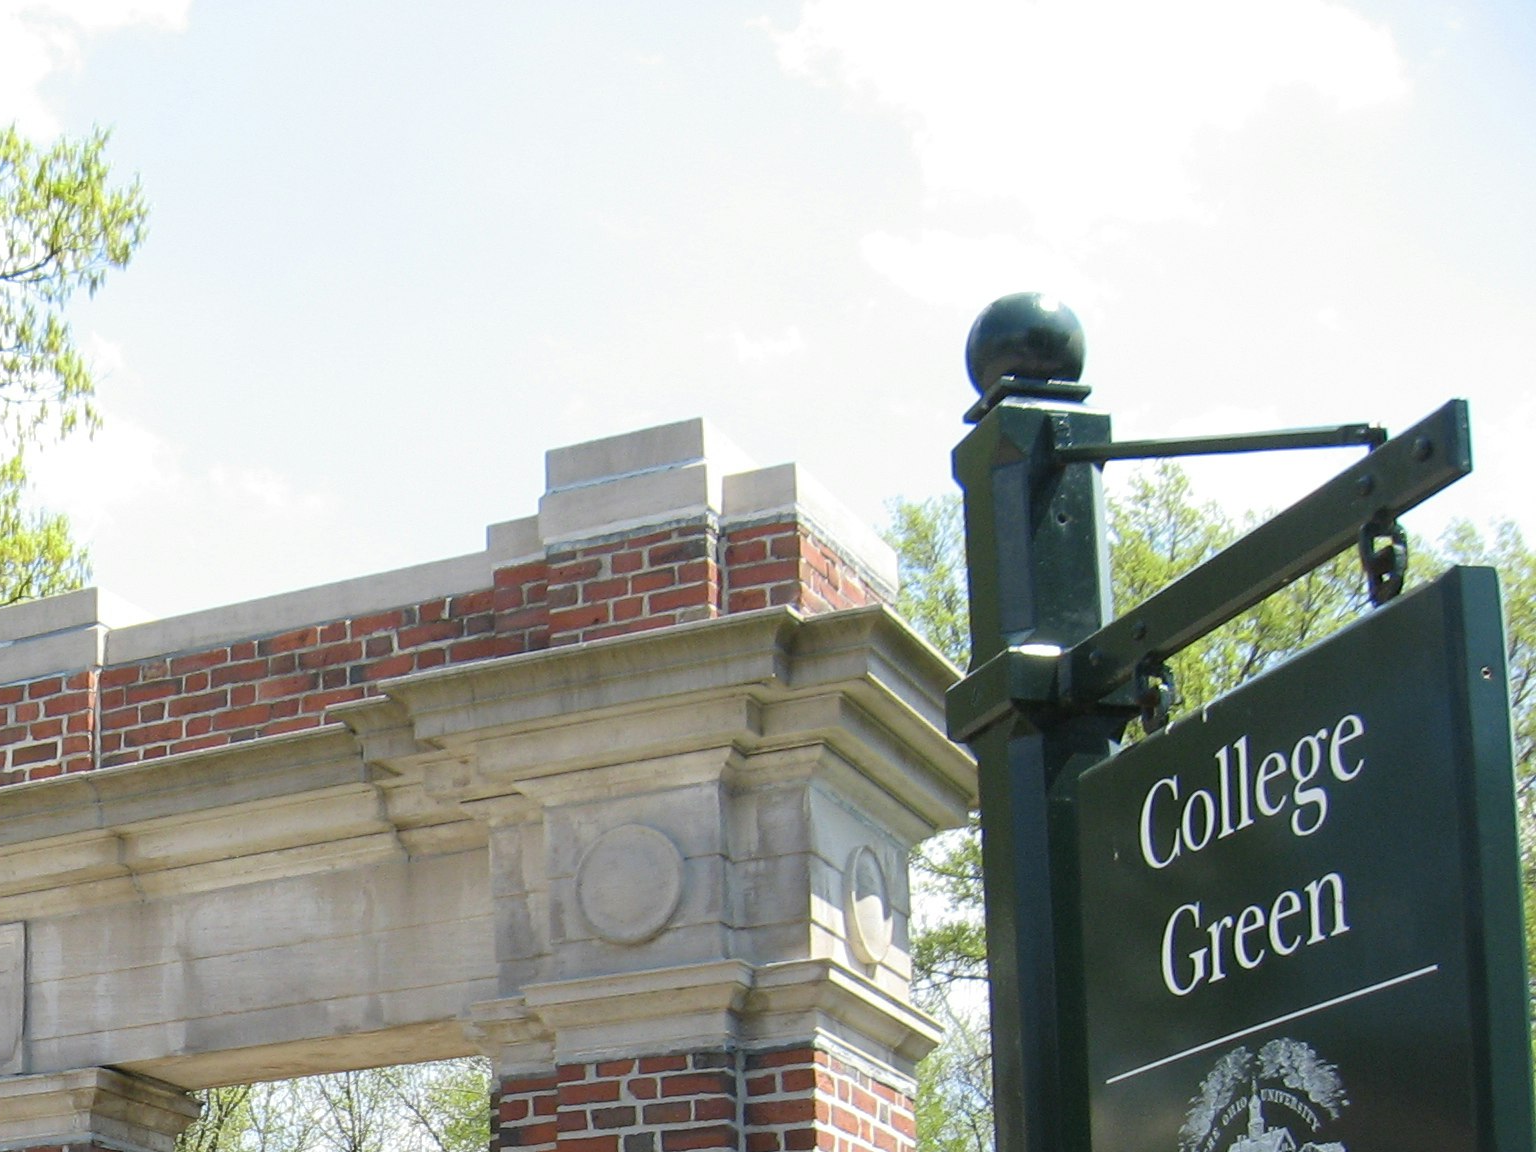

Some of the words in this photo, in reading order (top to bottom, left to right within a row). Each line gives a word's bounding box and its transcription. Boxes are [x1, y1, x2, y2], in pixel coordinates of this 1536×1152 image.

[1139, 713, 1365, 870] College
[1161, 872, 1351, 997] Green
[1222, 1096, 1248, 1126] OHIO
[1260, 1088, 1321, 1133] UNIVERSITY
